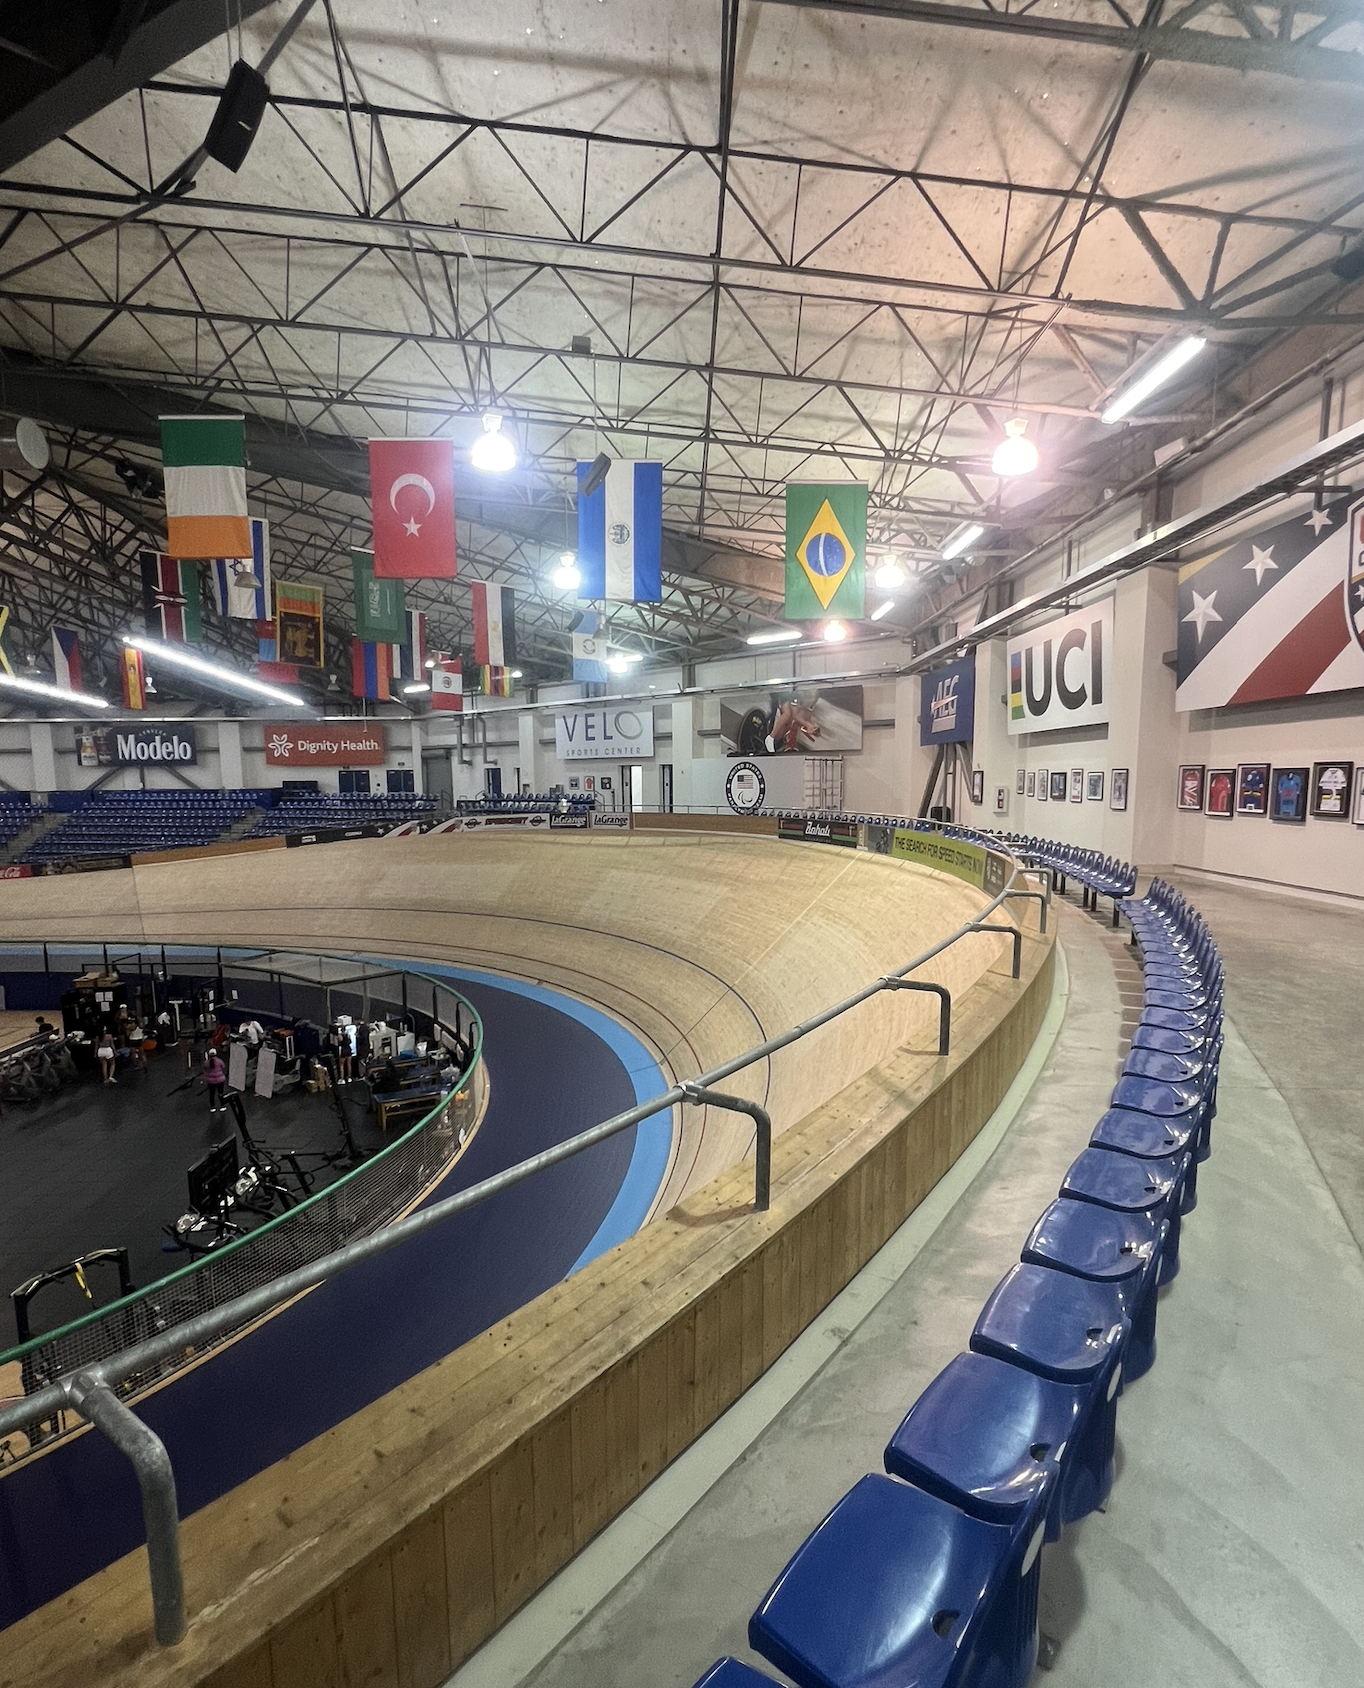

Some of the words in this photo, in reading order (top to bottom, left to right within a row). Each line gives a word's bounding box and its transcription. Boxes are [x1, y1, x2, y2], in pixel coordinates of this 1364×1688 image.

[1024, 620, 1102, 717] UCI
[932, 674, 960, 719] AEG
[562, 710, 643, 742] VELO
[116, 734, 192, 760] Modelo
[297, 740, 338, 754] Dignity
[341, 739, 379, 751] Health
[566, 748, 599, 757] SPORTS
[604, 747, 641, 756] CENTER
[895, 837, 906, 850] THE
[906, 838, 927, 855] SEARCH
[927, 843, 938, 858] FOR
[938, 846, 955, 864] SPEED
